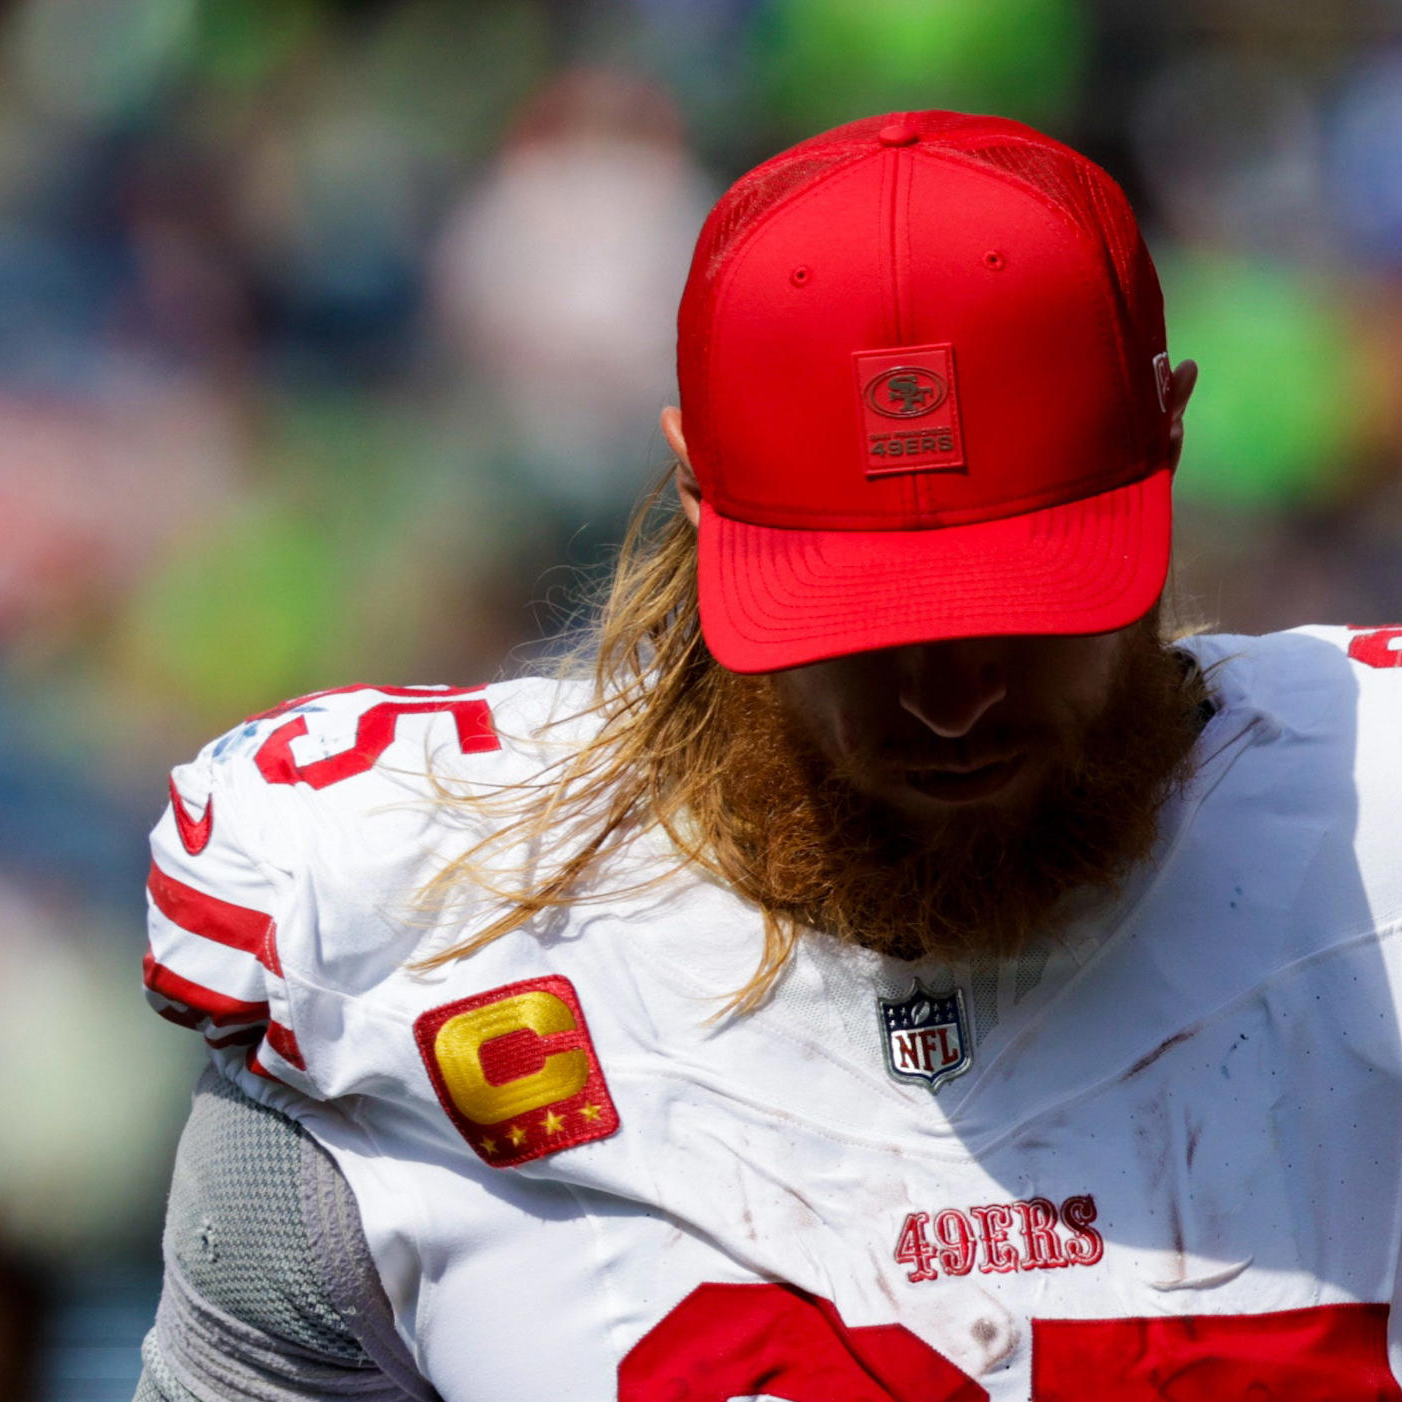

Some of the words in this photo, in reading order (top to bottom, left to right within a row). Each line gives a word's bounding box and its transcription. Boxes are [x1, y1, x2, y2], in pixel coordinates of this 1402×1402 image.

[870, 435, 954, 457] 49ERS
[434, 990, 589, 1126] C
[895, 1028, 959, 1072] NFL
[894, 1193, 1105, 1284] 49ERS
